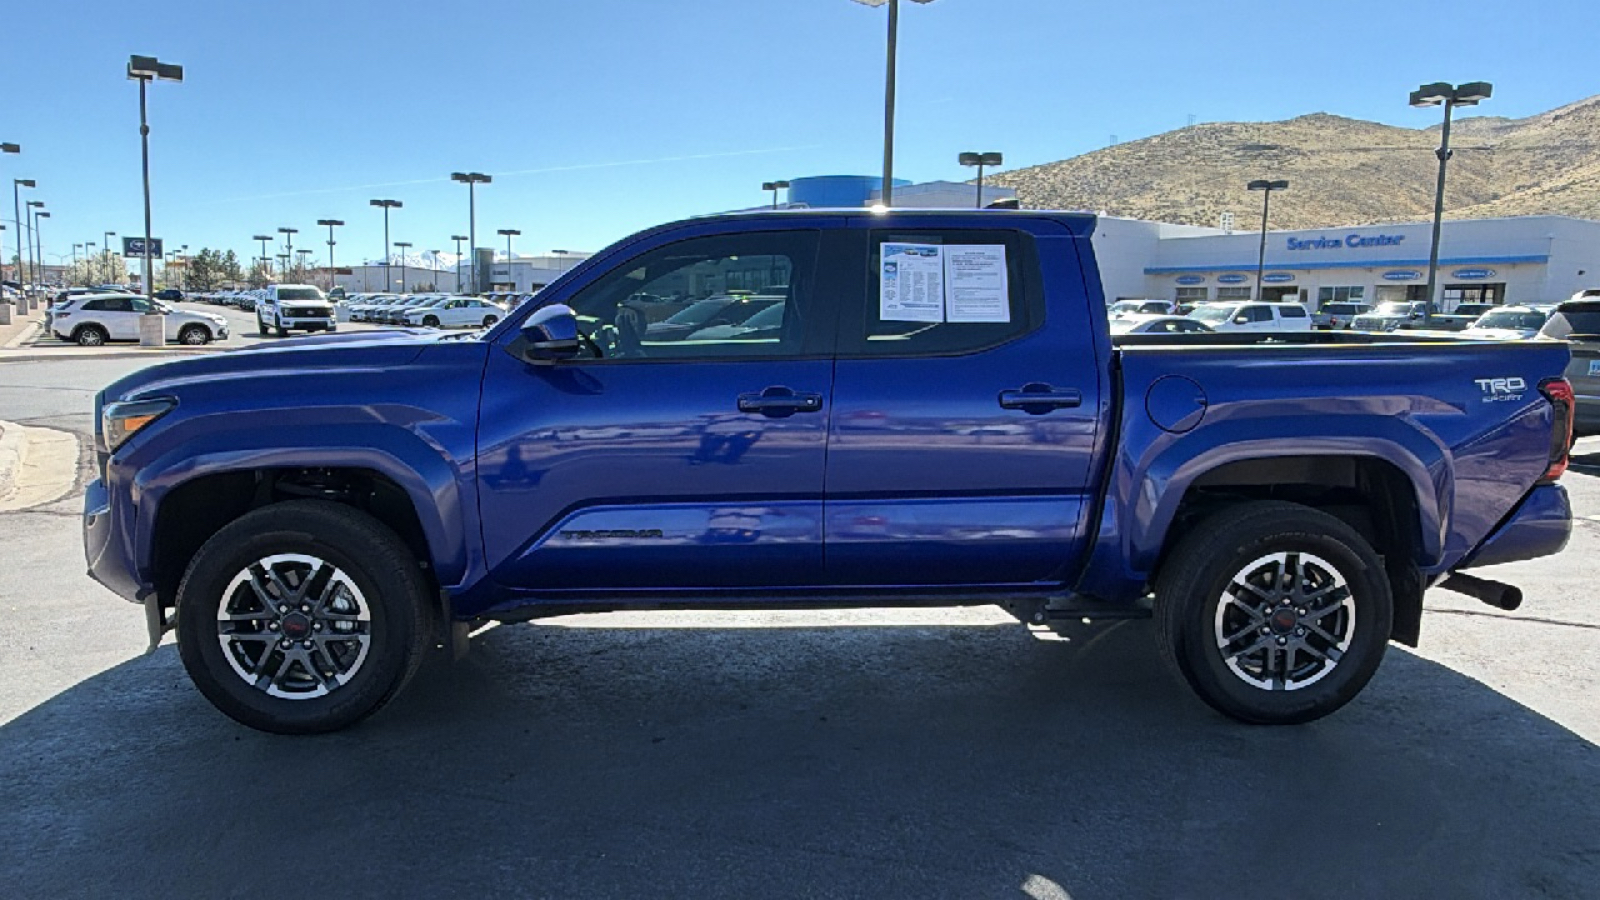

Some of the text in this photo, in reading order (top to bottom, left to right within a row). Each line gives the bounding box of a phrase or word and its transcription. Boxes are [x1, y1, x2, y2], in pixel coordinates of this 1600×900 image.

[1287, 234, 1405, 250] Service Center
[1474, 377, 1526, 394] TRD
[1482, 393, 1523, 403] SPORT
